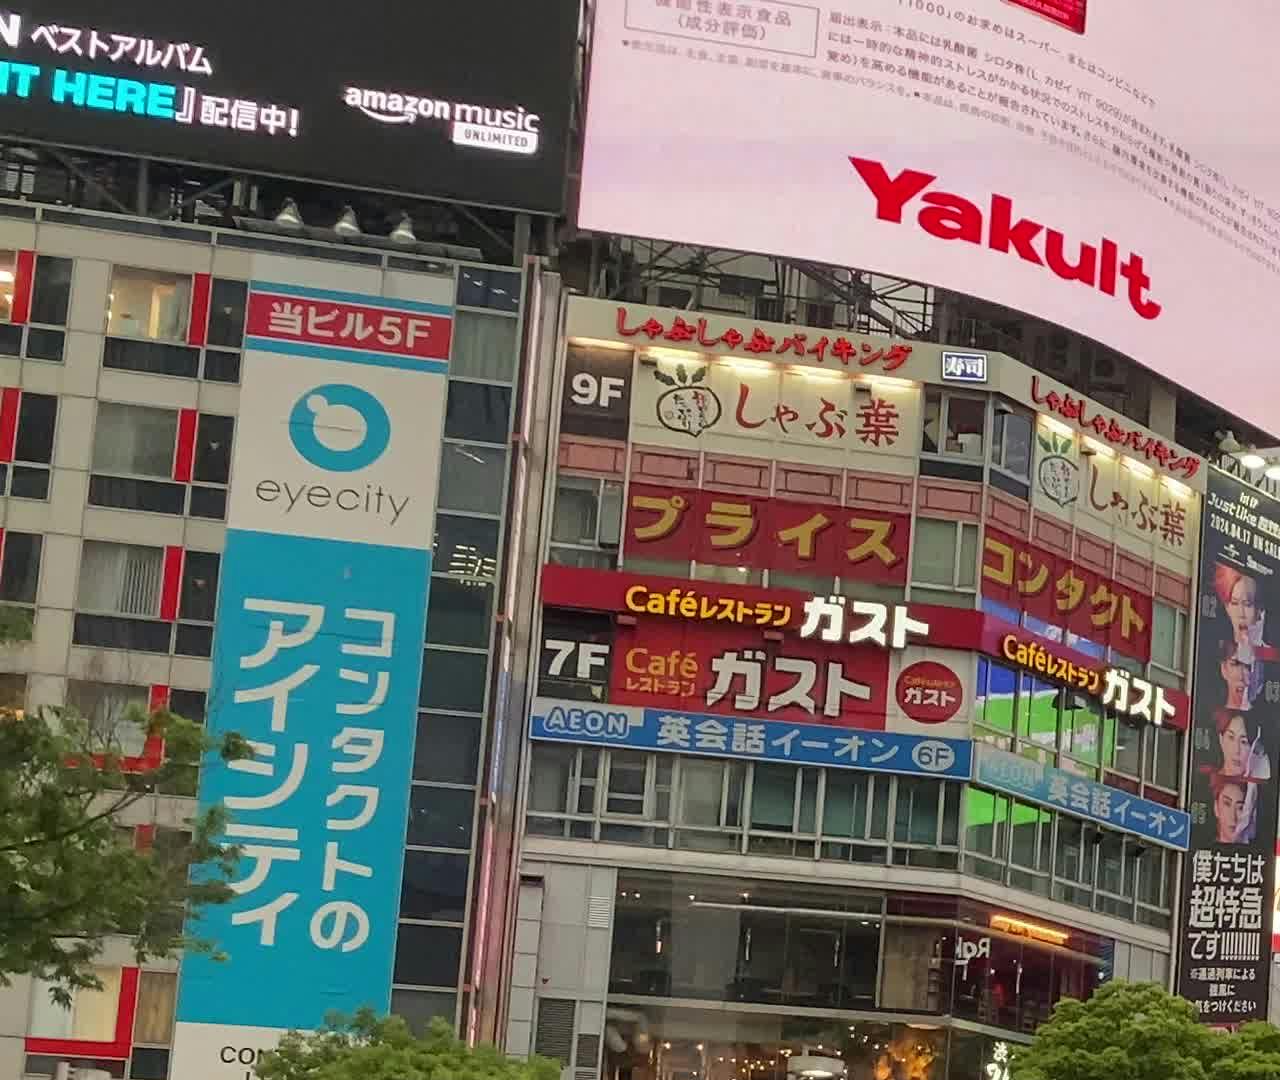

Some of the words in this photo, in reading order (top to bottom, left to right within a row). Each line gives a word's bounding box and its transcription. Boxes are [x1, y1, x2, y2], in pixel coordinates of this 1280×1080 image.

[31, 24, 213, 75] ベストアルバム
[345, 87, 451, 121] amazon
[454, 103, 540, 132] music
[464, 128, 528, 147] UNLIMITED
[848, 156, 1161, 320] Yakult
[268, 302, 432, 349] 当ビル5F
[616, 307, 913, 371] しゃぶしゃぶバイキング
[571, 373, 625, 407] 9F
[735, 383, 900, 447] しゃぶ葉
[1031, 375, 1201, 480] しゃぶしゃぶバイキング
[255, 477, 410, 526] eyecity
[1089, 463, 1187, 547] しゃぶ葉
[633, 495, 896, 568] プライス
[980, 535, 1146, 640] コンタクト
[624, 585, 791, 628] Caféレストラン
[800, 596, 930, 649] ガスト
[545, 639, 610, 680] 7F
[625, 647, 699, 680] Café
[706, 650, 871, 718] ガスト
[1003, 634, 1099, 691] Caféレストラン
[1103, 667, 1176, 727] ガスト
[625, 675, 696, 698] レストラン
[904, 686, 957, 707] ガスト
[543, 706, 629, 741] AEON
[656, 715, 900, 764] 英会話イーオン
[223, 598, 326, 947] アイシティ
[309, 607, 397, 953] コンタクトの
[917, 746, 952, 767] 6F
[1048, 776, 1186, 840] 英会話イーオン
[1192, 850, 1265, 885] 僕たちは
[1188, 886, 1263, 930] 超特急
